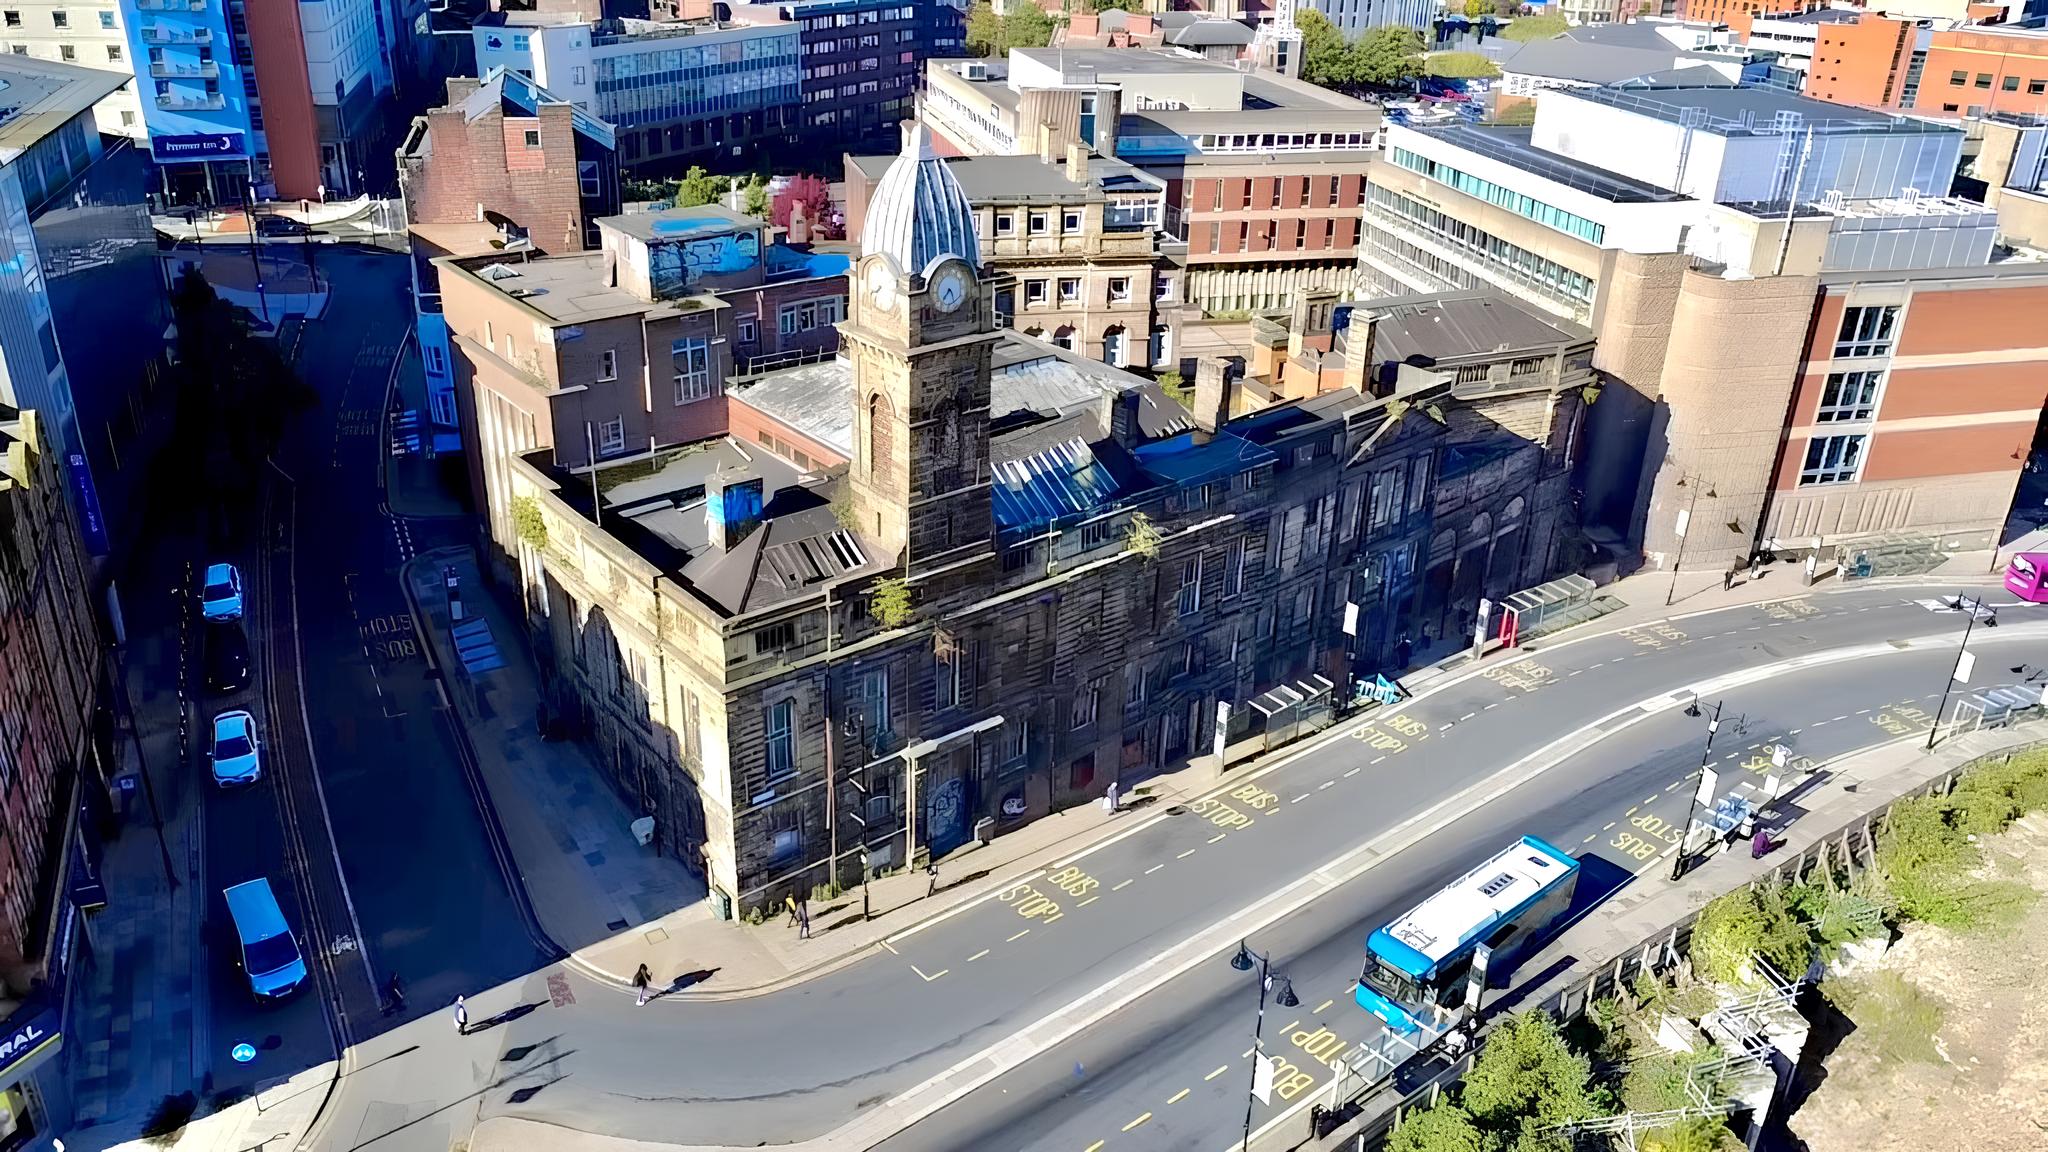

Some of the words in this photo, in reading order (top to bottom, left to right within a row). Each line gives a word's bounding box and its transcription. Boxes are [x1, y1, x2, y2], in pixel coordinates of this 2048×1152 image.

[1351, 726, 1402, 750] STOP
[1384, 714, 1428, 736] BUS
[1230, 784, 1279, 809] BUS
[1192, 799, 1248, 828] STOP
[1630, 814, 1684, 844] STOP
[1610, 832, 1657, 860] BUS
[1047, 866, 1099, 897] BUS
[999, 884, 1060, 919] STOP
